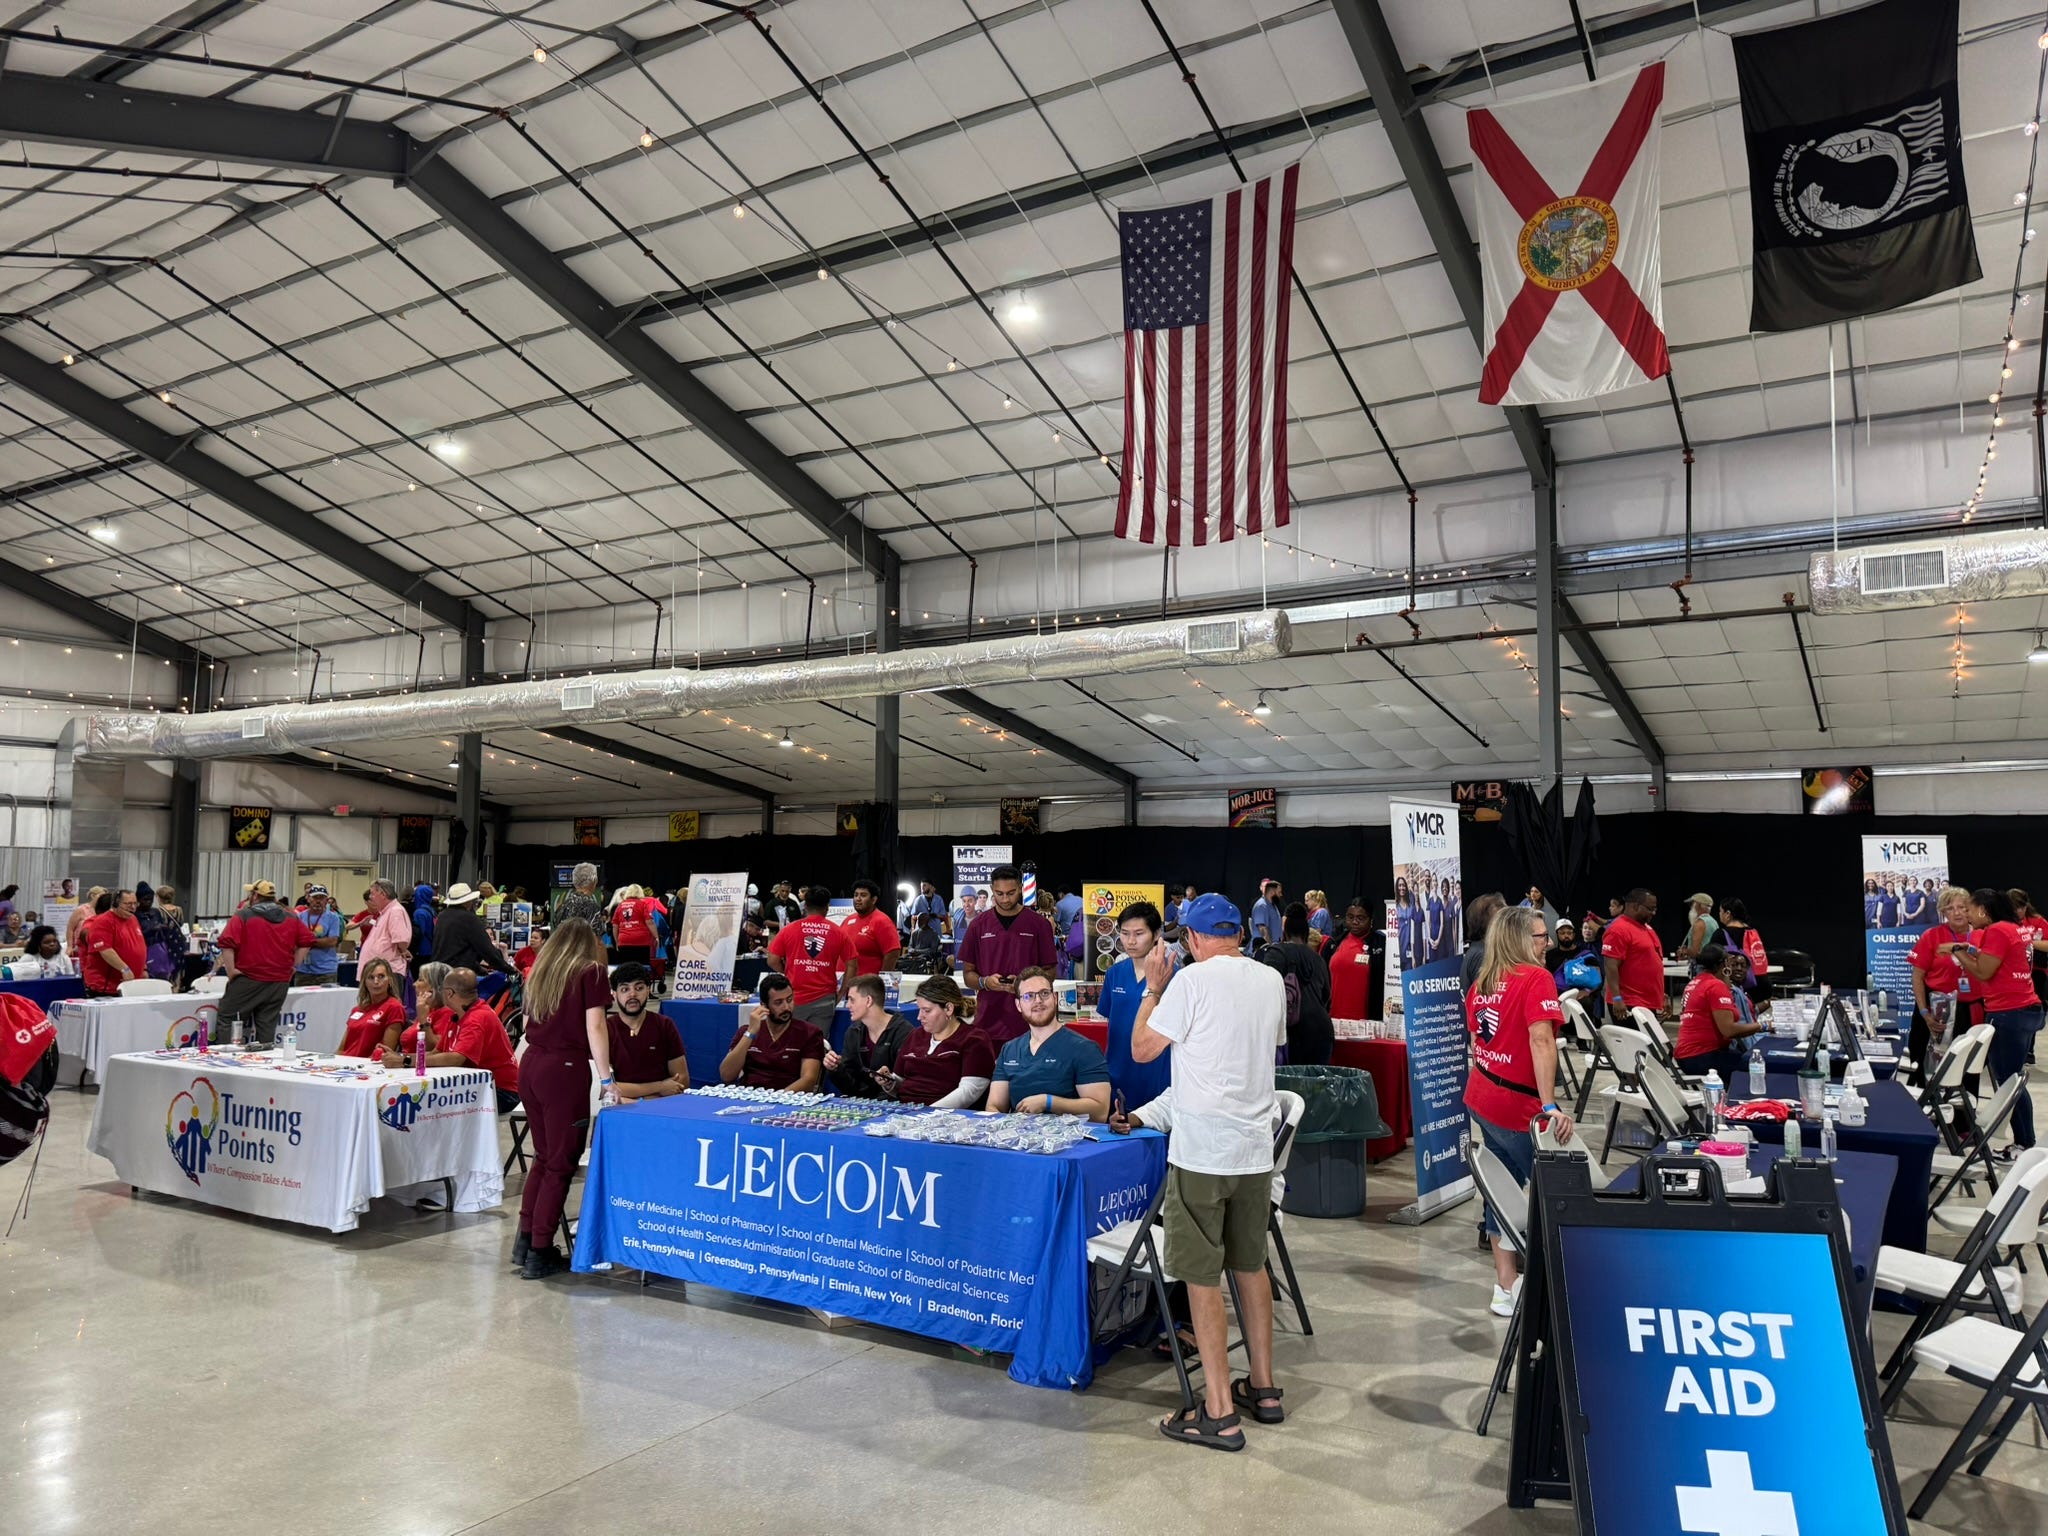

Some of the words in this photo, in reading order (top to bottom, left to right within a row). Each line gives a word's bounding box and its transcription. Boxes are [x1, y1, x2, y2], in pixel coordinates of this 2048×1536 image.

[1782, 143, 1797, 161] YOU
[1776, 163, 1787, 180] ARE
[1773, 181, 1783, 196] NOT
[1546, 198, 1576, 213] GREAT
[1580, 199, 1601, 209] SEAL
[1601, 206, 1610, 216] OF
[1773, 198, 1801, 237] FORGOTTEN
[1607, 217, 1616, 237] THE
[1599, 239, 1616, 265] STATE
[1590, 266, 1601, 276] OF
[1547, 275, 1586, 289] FLORIDA
[233, 807, 270, 819] DOMINO
[1416, 811, 1445, 836] MCR
[1416, 837, 1447, 849] HEALTH
[1893, 842, 1928, 855] MCR
[957, 848, 984, 858] MTC
[708, 887, 742, 895] CONNECTION
[801, 922, 830, 930] MANATEE
[802, 927, 829, 935] COUNTY
[1873, 934, 1896, 943] OUR
[679, 959, 708, 970] CARE.
[1409, 979, 1424, 995] OUR
[1425, 976, 1461, 993] SERVICES
[1473, 994, 1503, 1005] COUNTY
[427, 1088, 478, 1109] Points
[221, 1092, 303, 1146] Turning
[218, 1128, 275, 1164] Points
[207, 1162, 226, 1175] Where
[226, 1166, 262, 1182] Compassion
[262, 1172, 280, 1185] Takes
[280, 1177, 301, 1189] Action
[610, 1195, 635, 1210] College
[636, 1201, 645, 1211] of
[646, 1202, 683, 1218] Medicine
[690, 1209, 719, 1224] School
[720, 1216, 730, 1225] of
[731, 1216, 775, 1236] Pharmacy
[781, 1226, 812, 1241] School
[814, 1233, 824, 1243] of
[826, 1234, 857, 1249] Dental
[859, 1240, 902, 1259] Medicine
[910, 1250, 945, 1268] School
[947, 1259, 958, 1270] of
[961, 1260, 1007, 1281] Podiatric
[1008, 1270, 1037, 1286] Med
[637, 1219, 667, 1233] School
[667, 1225, 677, 1235] of
[676, 1226, 704, 1241] Health
[705, 1231, 742, 1248] Services
[743, 1238, 806, 1260] Administration
[811, 1251, 855, 1270] Graduate
[857, 1260, 888, 1278] School
[890, 1269, 902, 1280] of
[904, 1270, 960, 1293] Biomedical
[962, 1282, 1010, 1304] Sciences
[623, 1236, 642, 1249] Erie,
[642, 1240, 695, 1260] Pennsylvania
[704, 1252, 757, 1275] Greensburg,
[760, 1263, 819, 1285] Pennsylvania
[829, 1278, 862, 1297] Elmira,
[863, 1285, 886, 1301] New
[889, 1291, 912, 1306] York
[927, 1300, 988, 1325] Bradenton,
[1624, 1306, 1793, 1359] FIRST
[1664, 1365, 1776, 1417] AID
